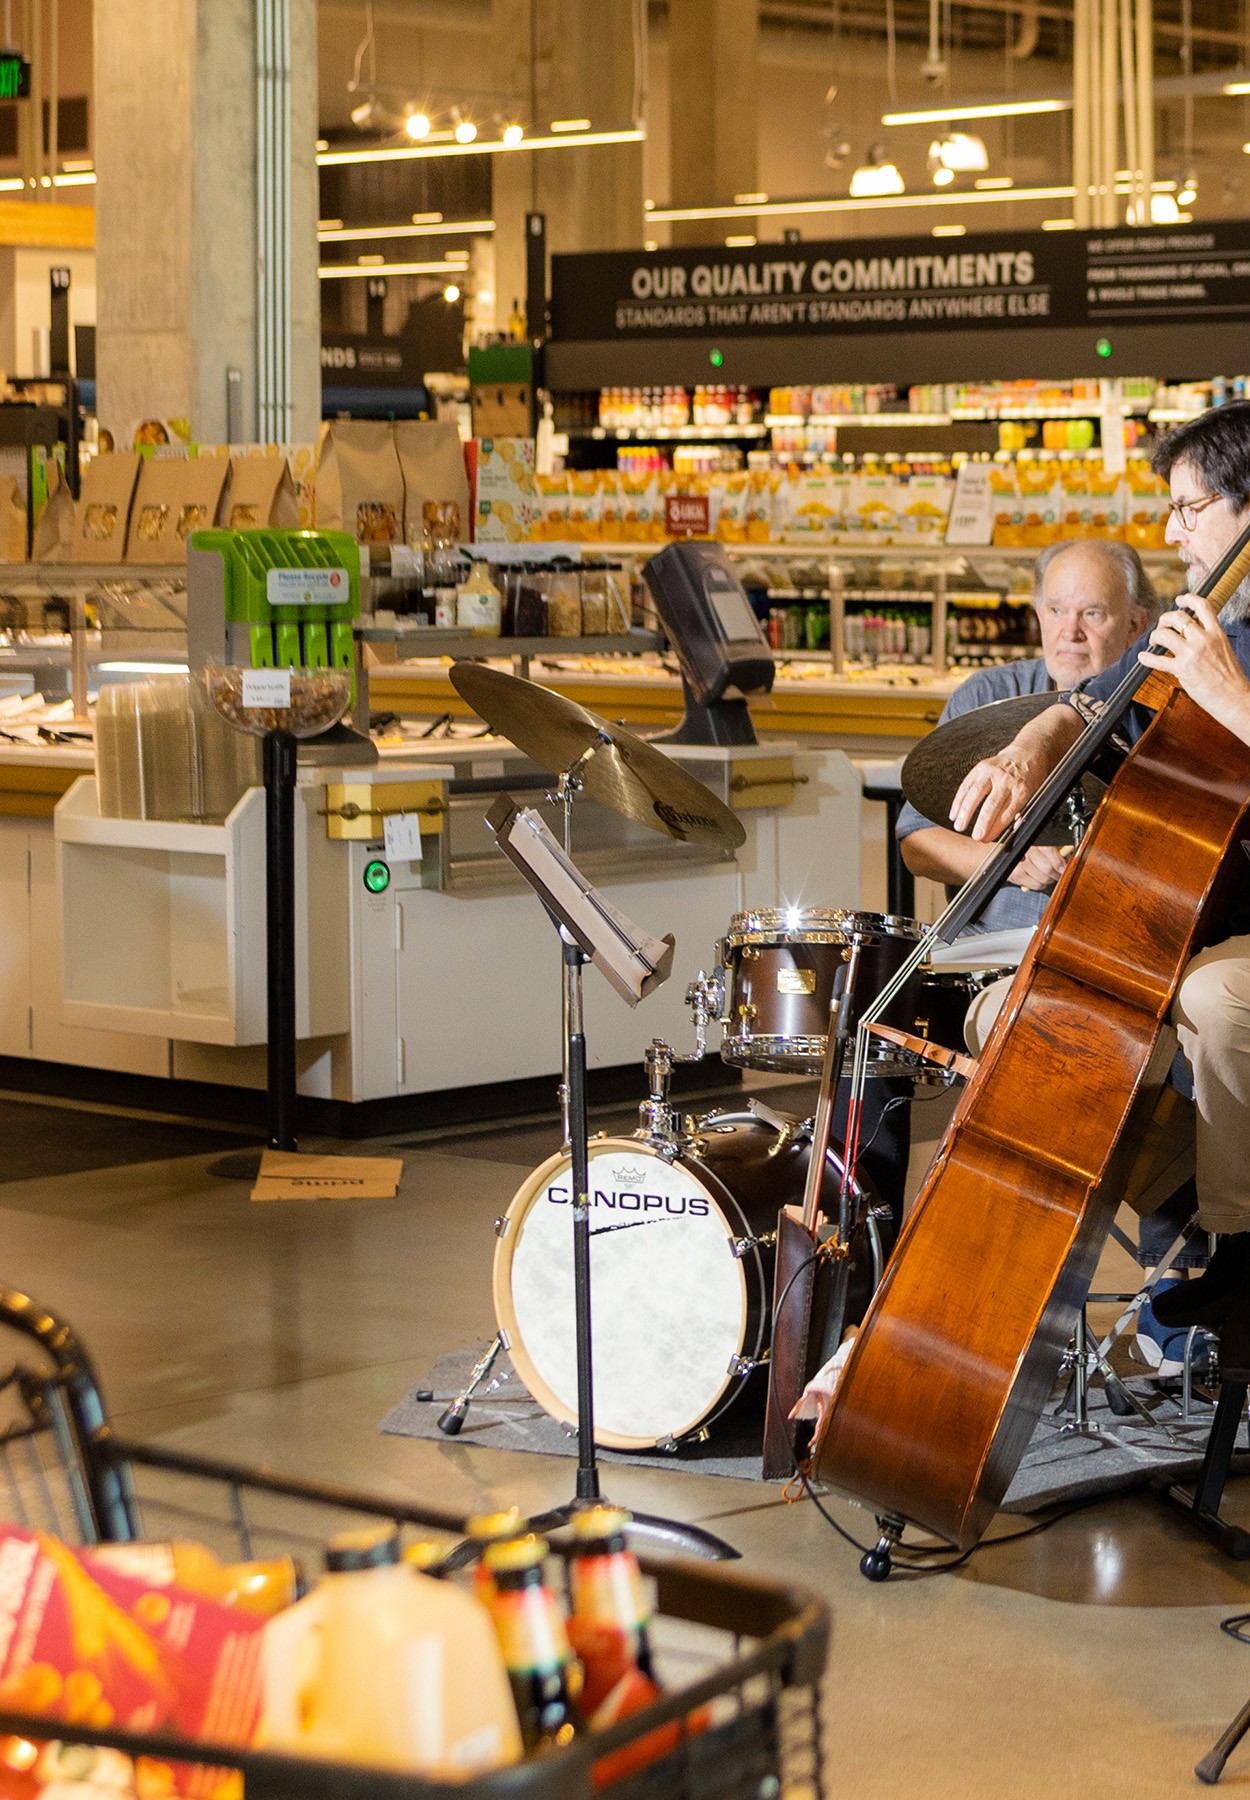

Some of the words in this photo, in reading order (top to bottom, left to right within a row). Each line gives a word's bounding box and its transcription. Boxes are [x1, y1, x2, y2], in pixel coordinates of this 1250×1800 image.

[631, 266, 687, 299] OUR
[690, 261, 807, 297] QUALITY
[811, 251, 1034, 292] COMMITMENTS
[616, 305, 705, 329] STANDARDS
[707, 304, 748, 326] THAT
[750, 301, 807, 324] AREN'T
[808, 299, 906, 322] STANDARDS
[908, 294, 1006, 319] ANYWHERE
[1008, 293, 1050, 316] ELSE
[548, 1187, 709, 1216] CNOPUS
